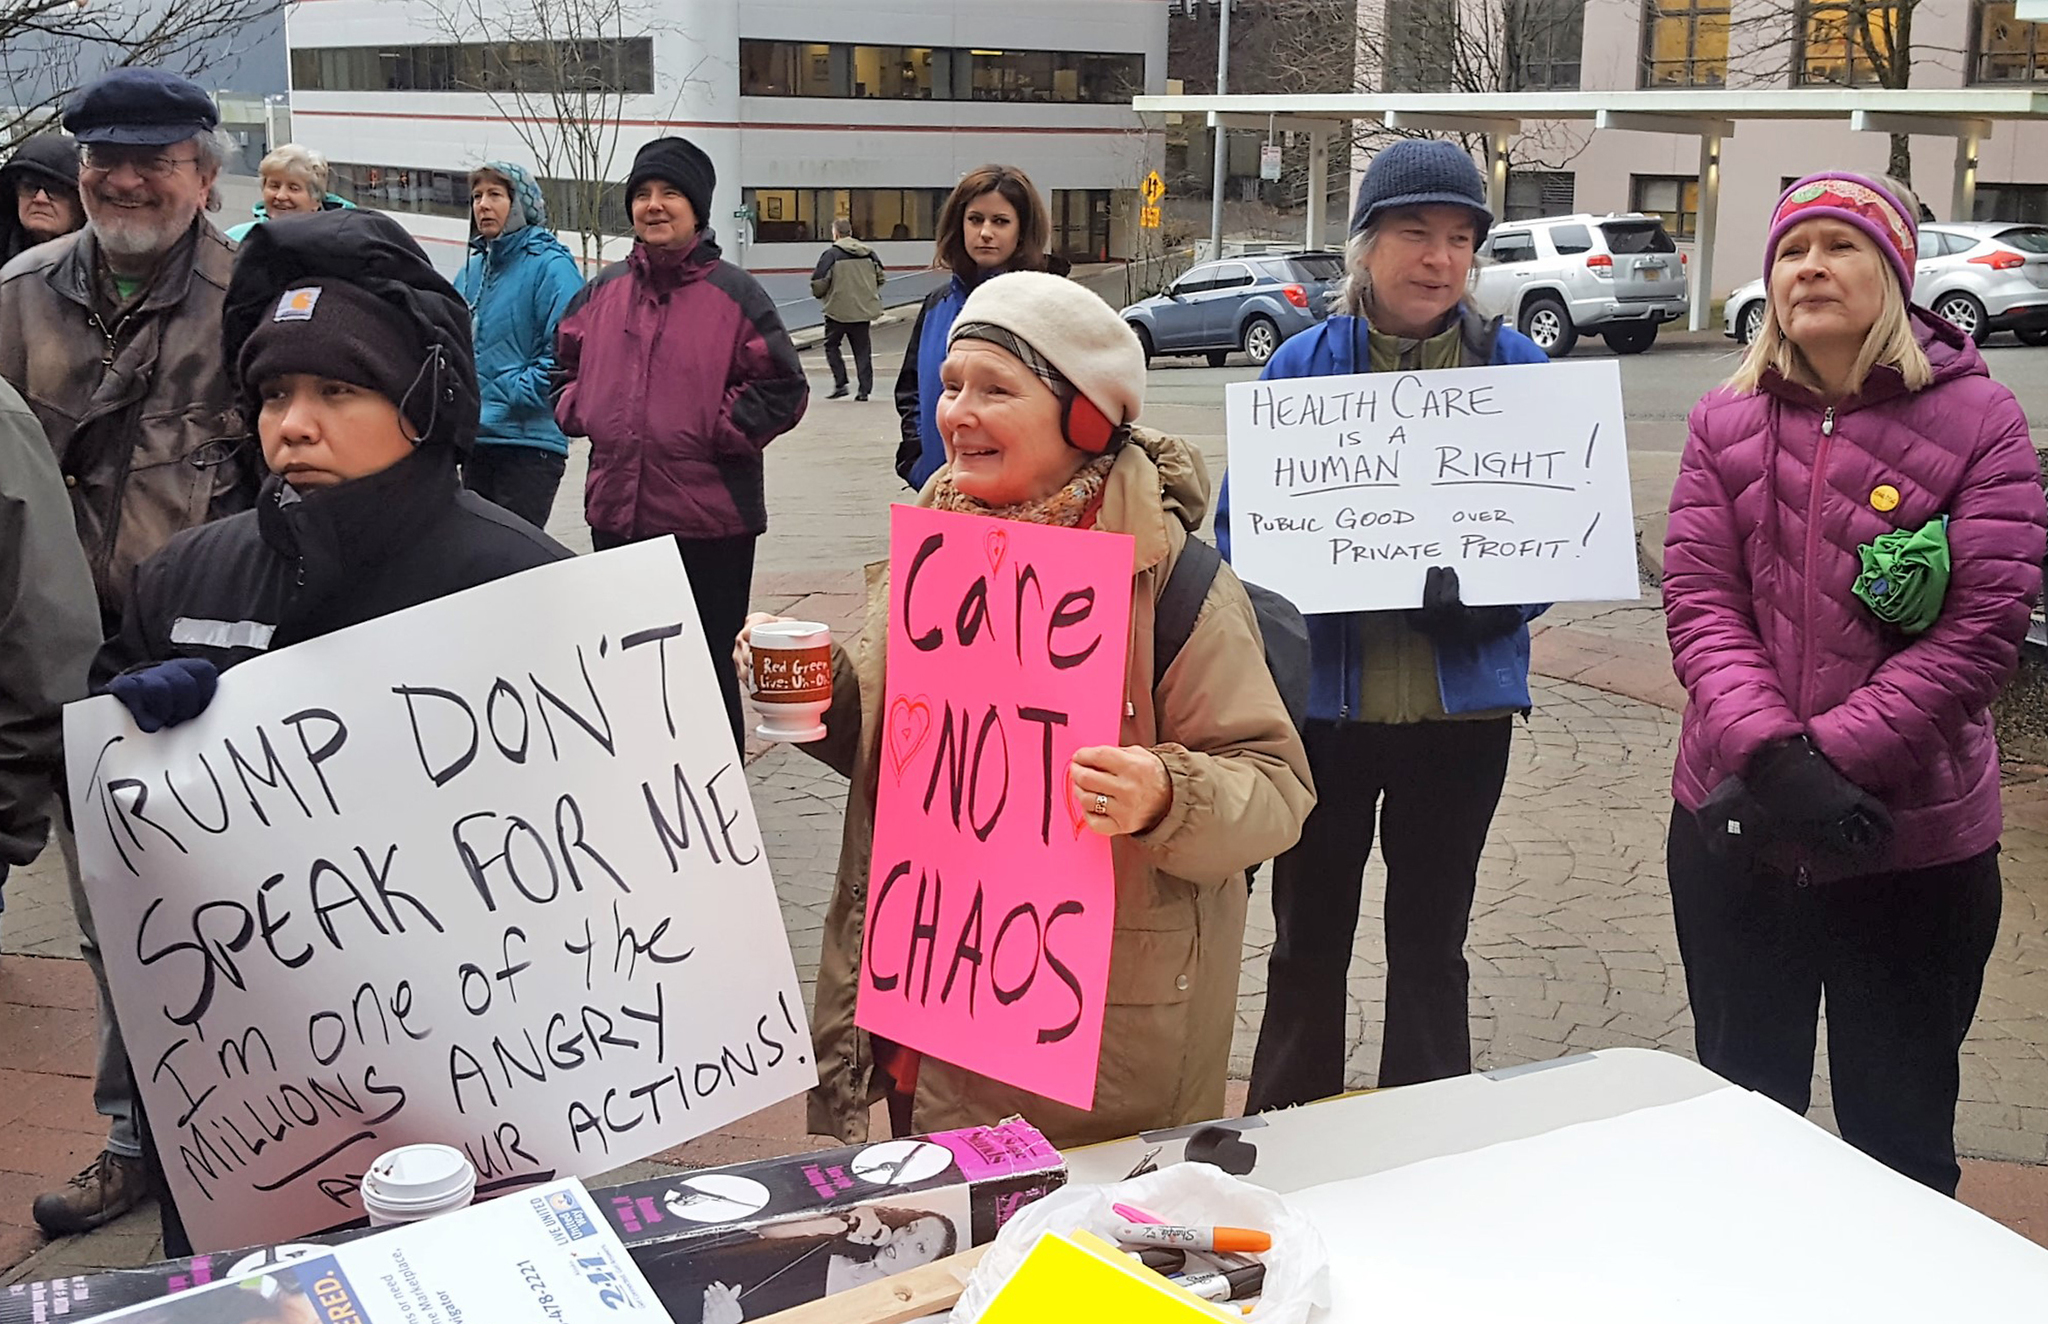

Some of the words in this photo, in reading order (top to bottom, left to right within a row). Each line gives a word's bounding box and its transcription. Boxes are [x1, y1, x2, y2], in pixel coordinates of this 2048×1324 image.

[1252, 387, 1376, 429] HEALTH
[1391, 375, 1503, 420] CARE
[1338, 431, 1362, 448] IS
[1388, 425, 1407, 445] A
[1275, 449, 1400, 487] HUMAN
[1247, 512, 1323, 534] PUBLIC
[1335, 507, 1415, 528] GOOD
[1452, 509, 1515, 525] OVER
[1329, 537, 1443, 565] PRIVATE
[903, 532, 1102, 670] Care
[763, 656, 788, 675] Red
[85, 707, 348, 877] TRUMP
[391, 622, 683, 788] DON'T
[922, 698, 1069, 847] NOT
[136, 843, 445, 1026] SPEAK
[452, 793, 632, 912] FOR
[641, 762, 760, 874] ME
[867, 860, 1086, 1045] CHAOS
[308, 979, 433, 1066] one
[458, 925, 533, 1016] of
[564, 898, 696, 991] the
[449, 981, 665, 1114] ANGRY
[317, 1173, 363, 1209] A
[464, 1121, 541, 1180] UR
[567, 990, 806, 1155] ACTIONS!
[529, 1197, 557, 1228] UNITED
[548, 1226, 570, 1247] LIVE
[557, 1211, 585, 1240] United
[380, 1273, 405, 1300] need
[391, 1247, 434, 1312] Marketplace,
[397, 1300, 412, 1312] or
[516, 1259, 569, 1324] -478-2221
